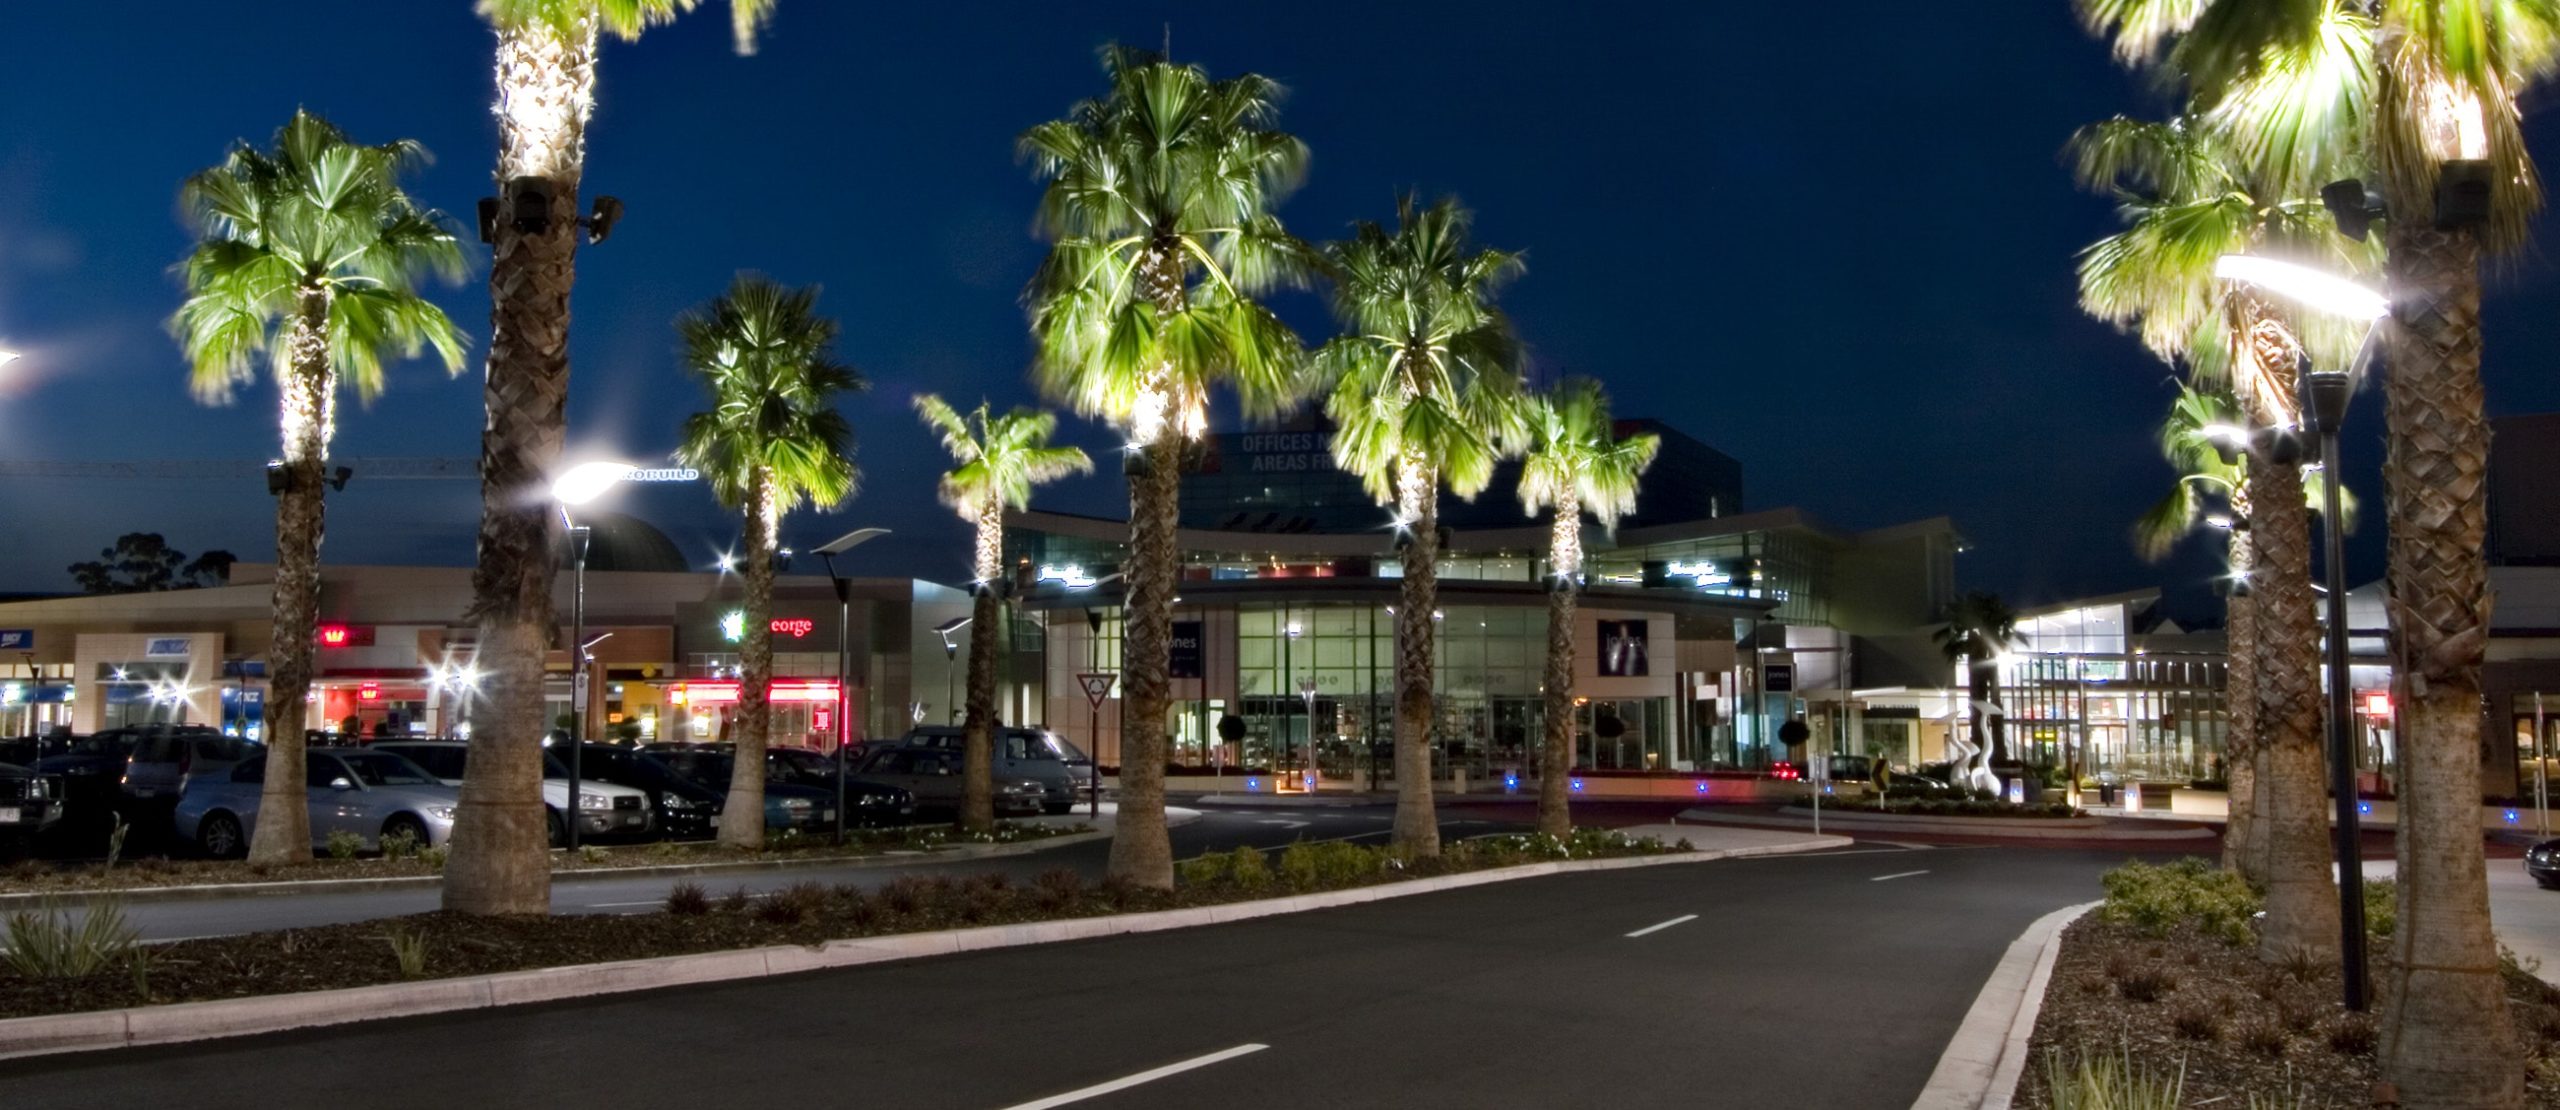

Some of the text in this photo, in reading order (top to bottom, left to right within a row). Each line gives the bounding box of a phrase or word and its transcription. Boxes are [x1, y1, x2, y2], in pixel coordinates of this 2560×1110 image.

[1242, 434, 1312, 452] OFFICES
[1252, 454, 1307, 471] AREAS
[771, 619, 812, 637] eorge
